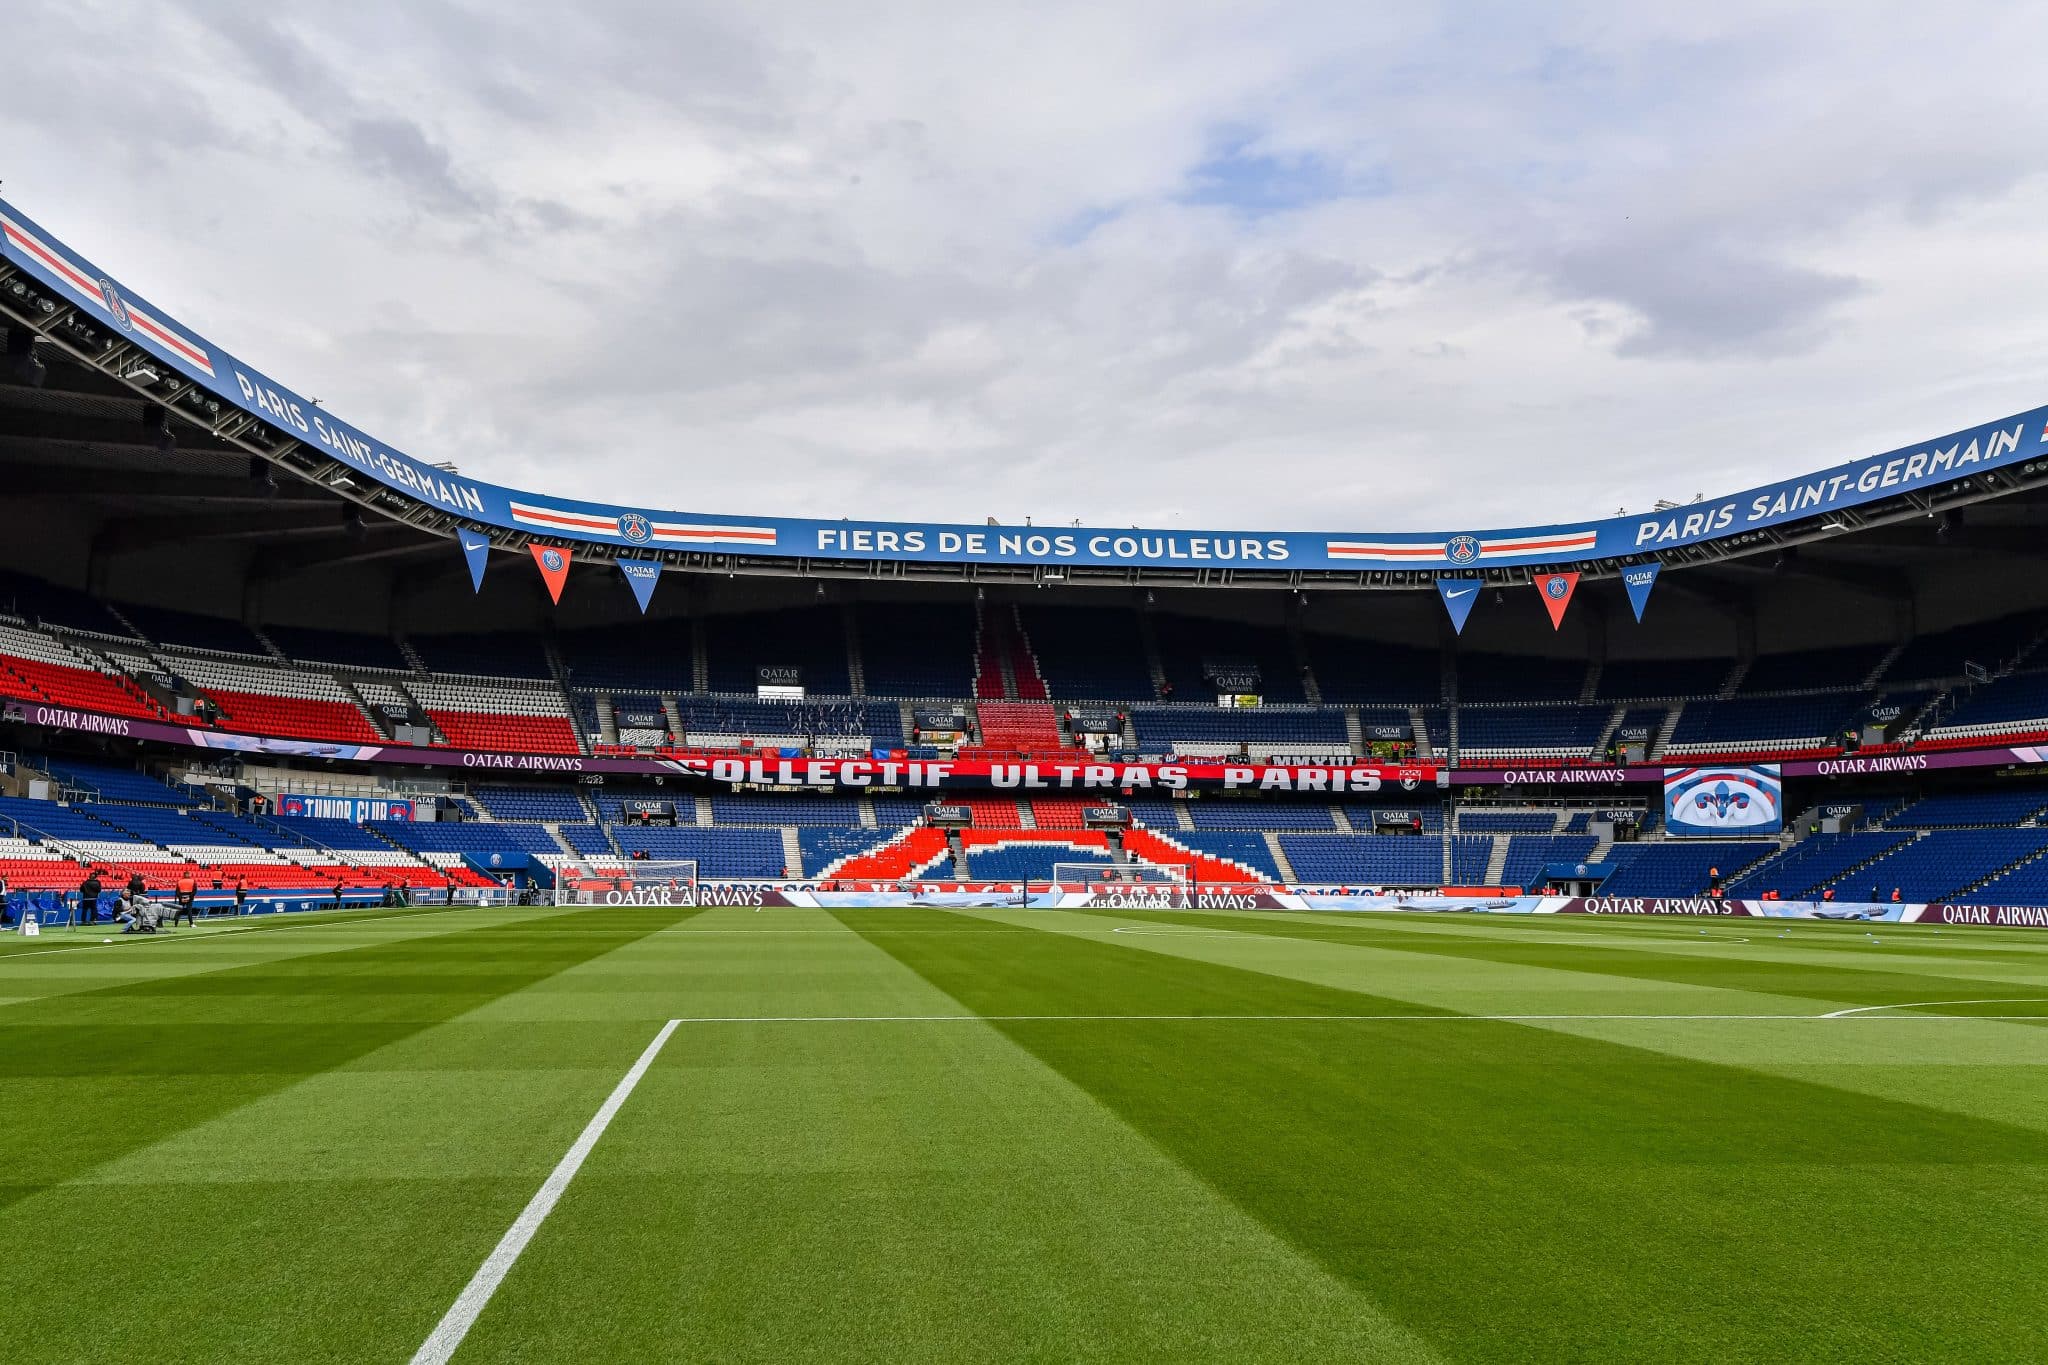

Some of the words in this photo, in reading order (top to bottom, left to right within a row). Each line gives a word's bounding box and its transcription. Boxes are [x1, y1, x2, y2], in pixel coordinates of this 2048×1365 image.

[235, 371, 309, 433] PARIS
[313, 416, 485, 513] SAINT-GERMAIN
[1635, 504, 1736, 546] PARIS
[1747, 424, 2024, 522] SAINT-GERMAIN
[817, 529, 926, 552] FIERS
[939, 532, 987, 554] DE
[1000, 534, 1077, 557] NOS
[1088, 536, 1290, 560] COULEURS
[624, 565, 655, 574] QATAR
[1625, 571, 1652, 583] QATAR
[760, 669, 798, 678] QATAR
[1216, 677, 1253, 686] QATAR
[382, 706, 408, 714] QATAR
[1872, 706, 1900, 717] QATAR
[37, 706, 78, 730] QATAR
[80, 713, 129, 736] AIRWAYS
[627, 714, 654, 723] QATAR
[928, 716, 954, 724] QATAR
[1375, 727, 1400, 735] QATAR
[1621, 728, 1648, 736] QATAR
[463, 753, 513, 769] QATAR
[518, 757, 583, 771] AIRWAYS
[1817, 759, 1866, 775] QATAR
[1869, 755, 1927, 772] AIRWAYS
[990, 764, 1188, 789] ULTRAS
[1224, 767, 1382, 792] PARIS
[1503, 770, 1556, 784] QATAR
[1560, 769, 1625, 782] AIRWAYS
[634, 801, 661, 809] QATAR
[1826, 806, 1851, 815] QATAR
[1093, 808, 1118, 816] QATAR
[1606, 811, 1634, 819] QATAR
[606, 891, 672, 907] QATAR
[681, 891, 763, 907] ARWAYS
[1110, 893, 1171, 908] QATAR
[1179, 894, 1257, 909] ARWAYS
[1584, 898, 1645, 913] QATAR
[1942, 905, 1990, 925] QATAR
